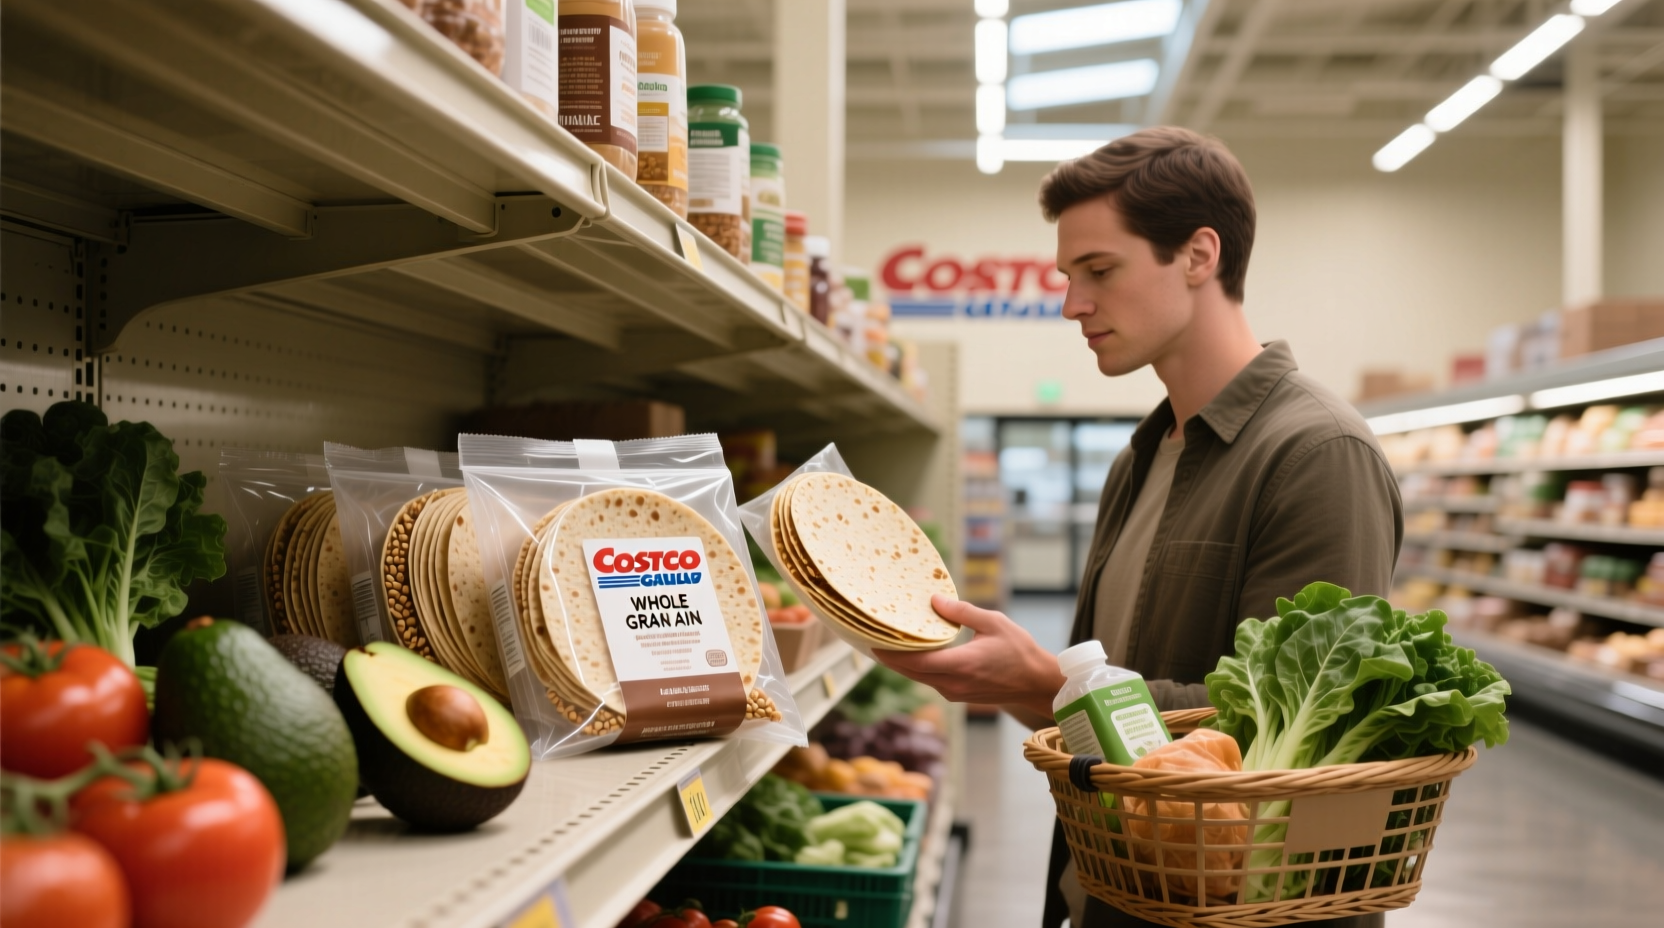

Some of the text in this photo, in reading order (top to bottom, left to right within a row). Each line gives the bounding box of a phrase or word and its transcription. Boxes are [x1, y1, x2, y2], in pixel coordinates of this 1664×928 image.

[881, 245, 1069, 293] COSTC
[593, 547, 701, 573] COSTCO
[630, 594, 690, 611] WHOLE
[626, 610, 703, 630] GRAN AIN
